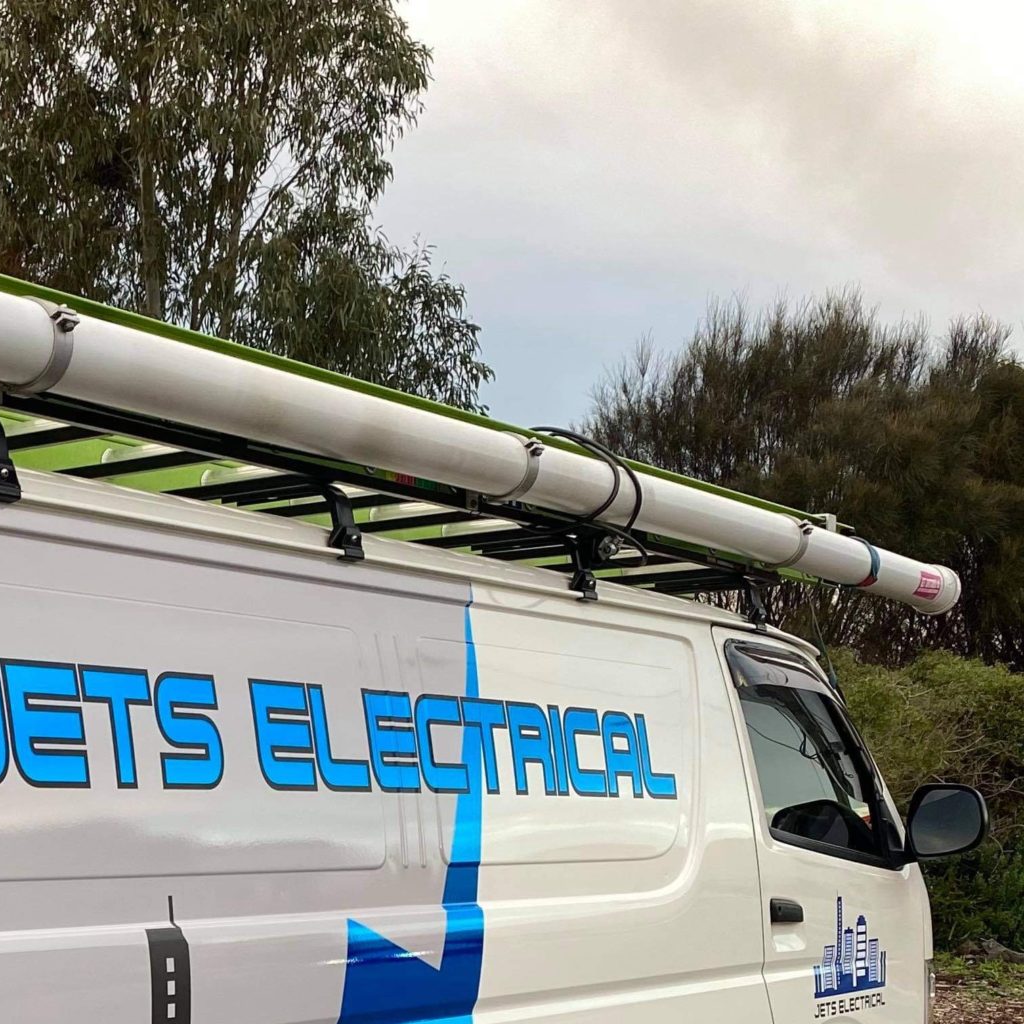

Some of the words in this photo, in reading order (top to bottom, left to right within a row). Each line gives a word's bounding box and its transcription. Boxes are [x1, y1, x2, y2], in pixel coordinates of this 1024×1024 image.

[247, 678, 678, 800] ELECTRICAL
[814, 1001, 837, 1018] JETS
[839, 992, 886, 1014] ELECTRICAL
